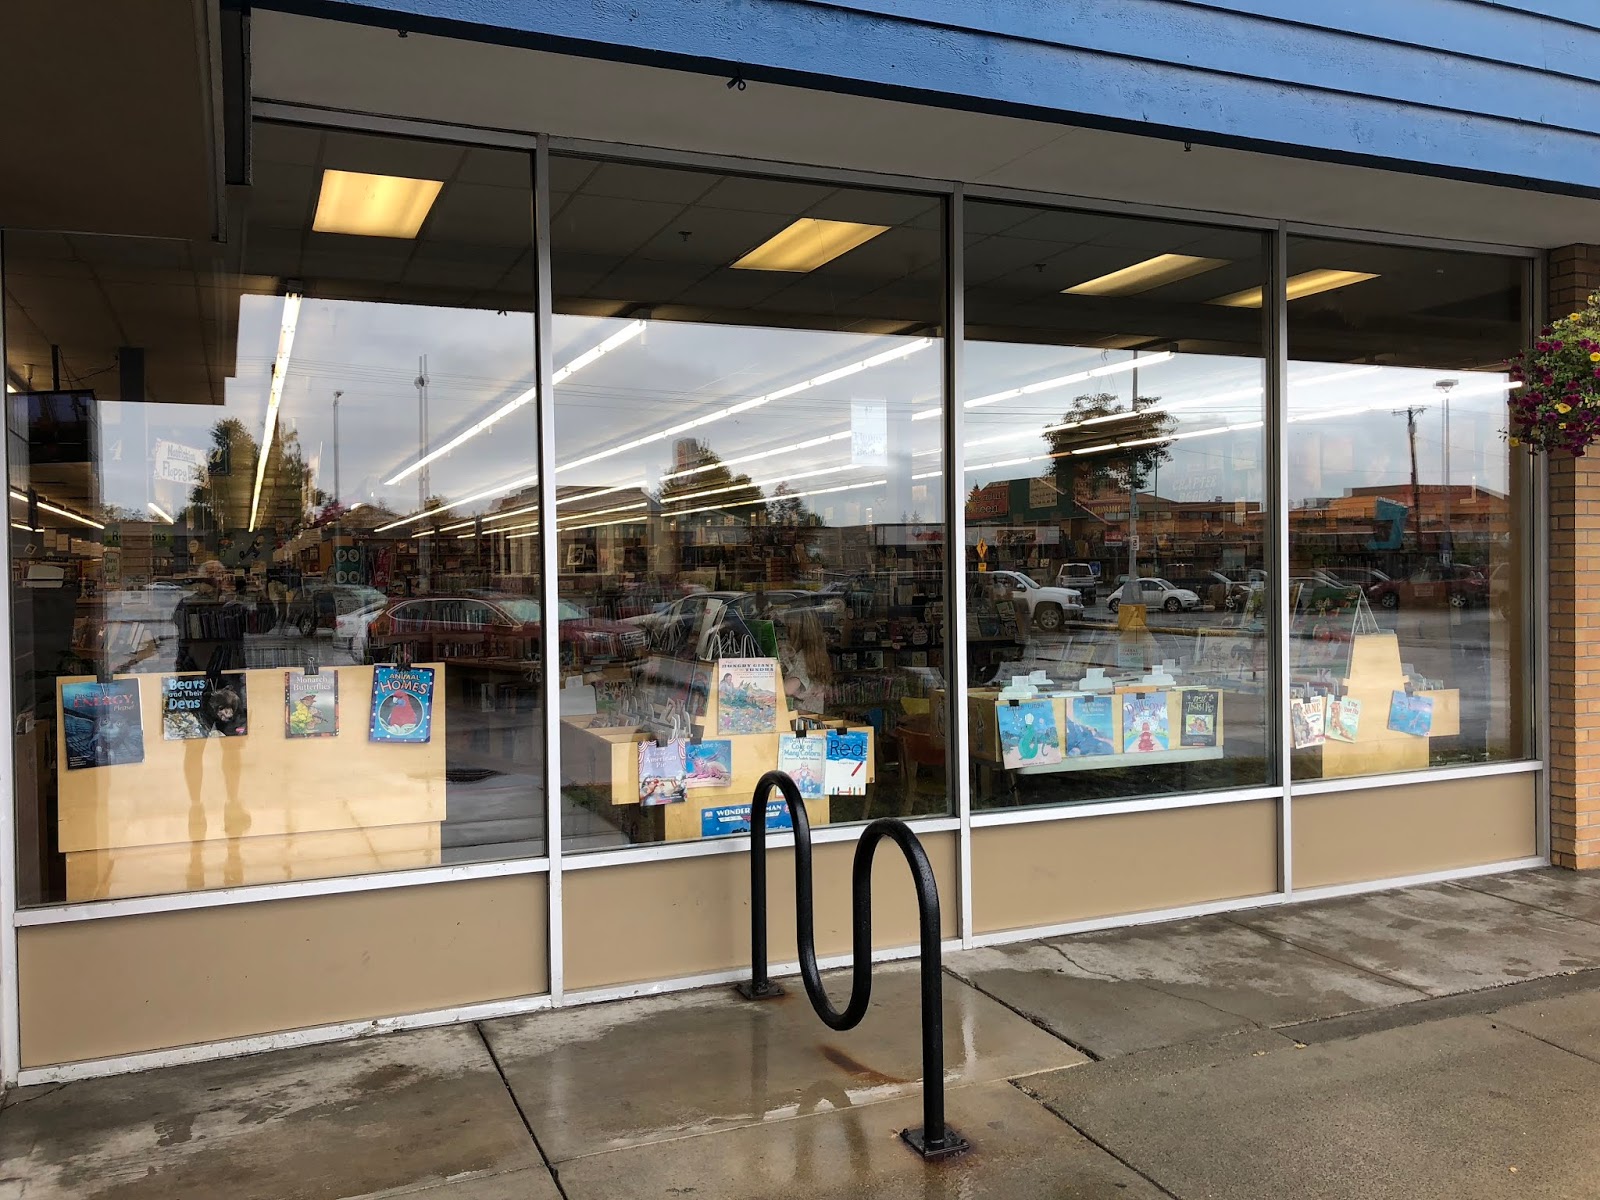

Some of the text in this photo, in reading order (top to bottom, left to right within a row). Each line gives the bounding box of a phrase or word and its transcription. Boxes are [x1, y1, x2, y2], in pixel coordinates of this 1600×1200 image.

[162, 462, 188, 481] Floppy
[296, 676, 328, 684] Monarch
[389, 672, 420, 681] ANIMAL
[168, 678, 206, 690] Bears
[293, 683, 331, 691] Butterflies
[380, 680, 428, 695] HOMES
[168, 689, 203, 698] and Their
[168, 698, 201, 710] Dens
[830, 739, 864, 757] Red
[783, 749, 821, 758] Many Colors
[645, 754, 677, 763] American
[655, 761, 667, 769] Pie
[716, 807, 751, 817] WONDER
